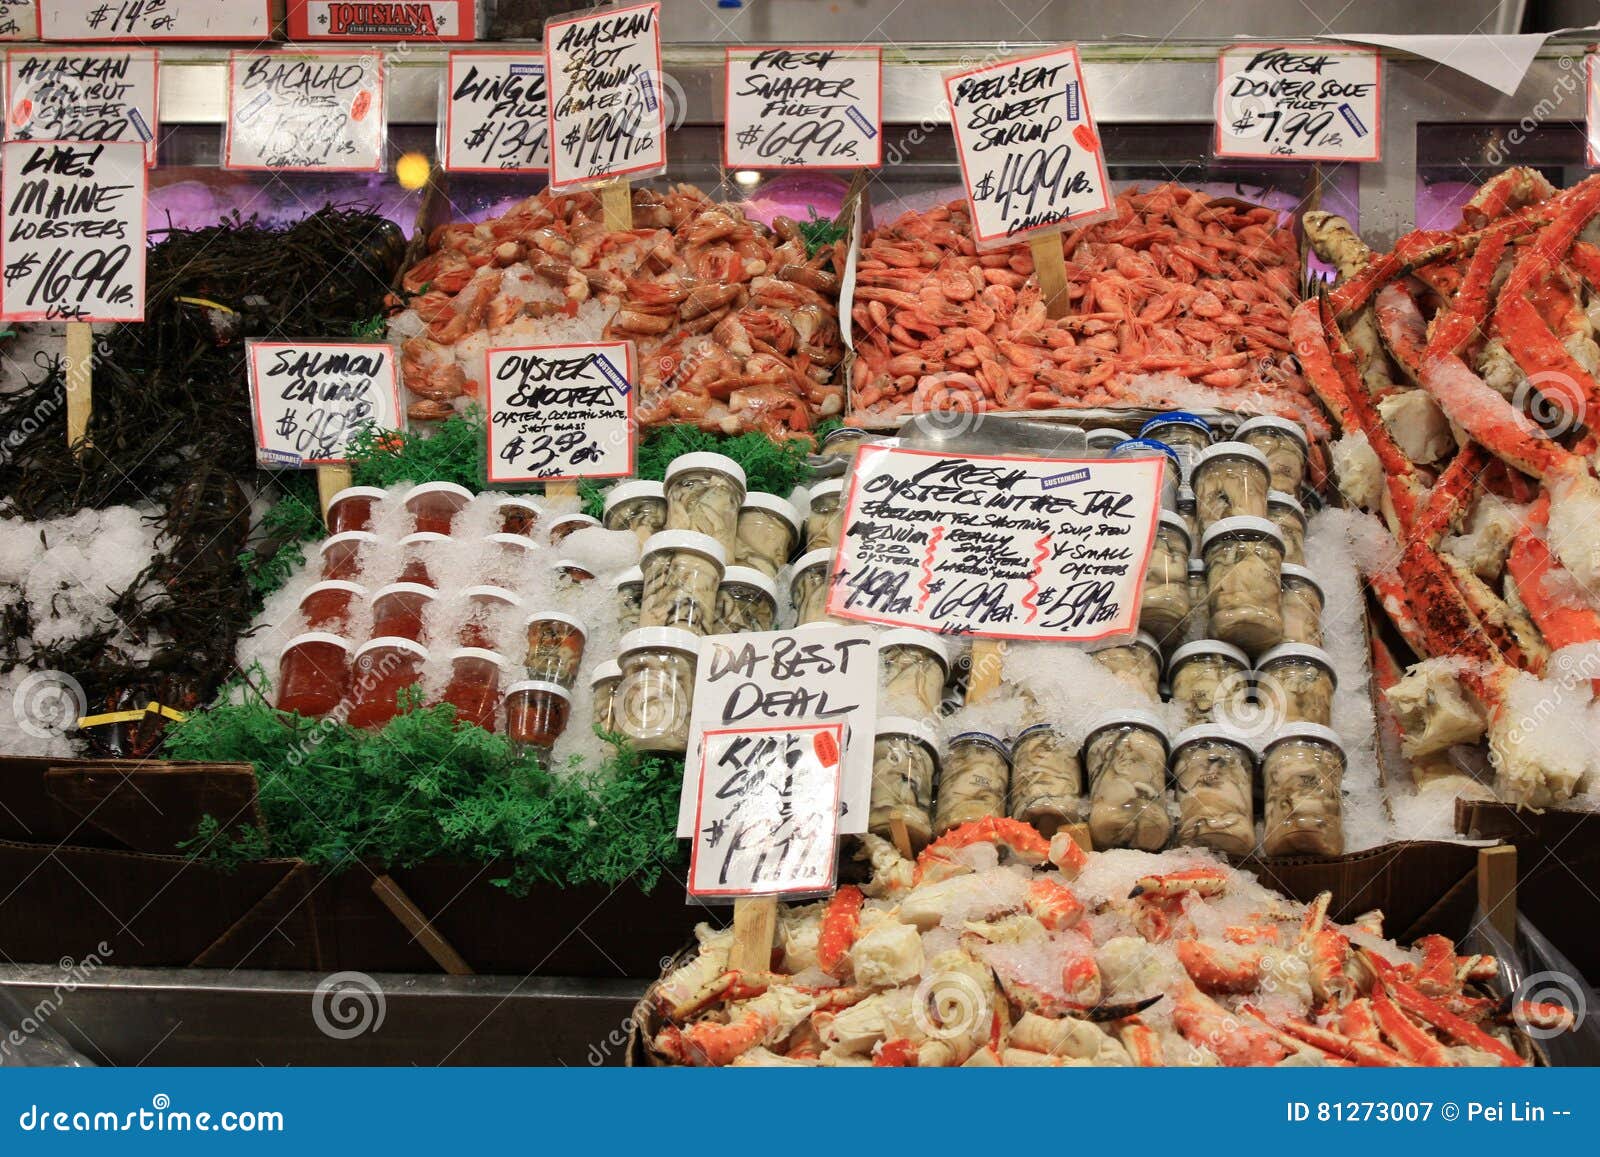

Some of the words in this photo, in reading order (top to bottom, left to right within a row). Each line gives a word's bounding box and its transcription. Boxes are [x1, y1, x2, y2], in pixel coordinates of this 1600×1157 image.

[328, 3, 438, 34] LOUISIANA
[556, 8, 654, 51] ALASKAN
[18, 53, 131, 83] ALASKAN
[563, 43, 638, 73] SPOT
[750, 49, 844, 71] FRESH
[1245, 48, 1339, 75] FRESH
[242, 55, 364, 94] BACALAO
[565, 64, 641, 95] PRAWNS
[736, 73, 860, 100] SNAPPER
[1231, 76, 1316, 100] DOVER
[1318, 79, 1377, 99] SOLE
[760, 100, 847, 118] FILLET
[967, 91, 1066, 129] SWEET
[1276, 98, 1337, 110] FILLET
[972, 116, 1063, 151] SHRIMP
[21, 144, 104, 178] LIVE!
[588, 162, 622, 178] USA
[8, 179, 135, 219] MAINE
[9, 218, 128, 243] LOBSTERS
[1006, 206, 1080, 238] CANADA
[46, 303, 91, 322] USA
[266, 349, 384, 378] SALMON
[496, 353, 597, 387] OYSTER
[597, 357, 628, 392] SUSTAINABLE
[281, 378, 373, 404] CAVIAR
[506, 384, 615, 408] SHOOTERS
[492, 410, 546, 427] OYSTER,
[518, 424, 551, 434] SHOT
[554, 422, 586, 431] GLASS
[912, 459, 1038, 491] FRESH
[1043, 471, 1089, 487] SUSTAINABLE
[863, 474, 987, 505] OYSTERS
[1075, 490, 1136, 519] JAR
[846, 521, 929, 545] MEDIUM
[944, 529, 1014, 547] REALLY
[1058, 522, 1094, 541] SOUP,
[857, 551, 920, 567] OYSTERS
[951, 542, 1019, 558] SMALL
[1059, 562, 1129, 581] OYSTERS
[770, 636, 870, 681] BEST
[721, 682, 860, 724] DEAL
